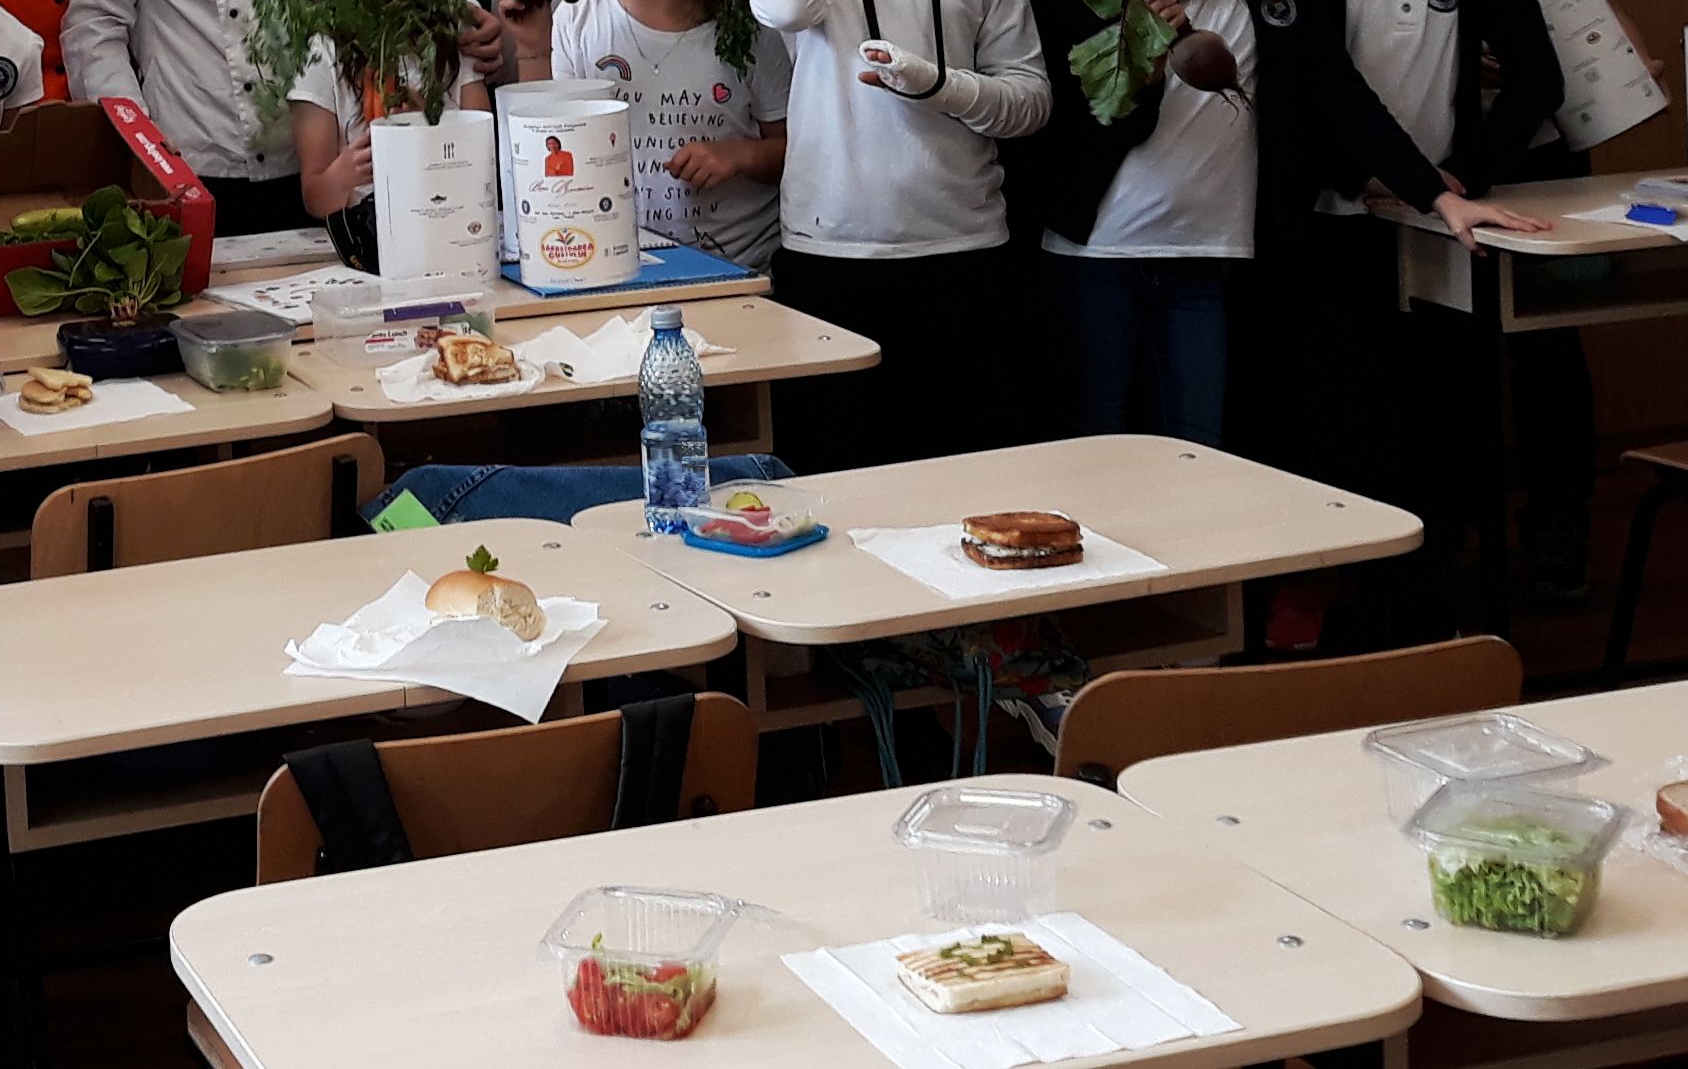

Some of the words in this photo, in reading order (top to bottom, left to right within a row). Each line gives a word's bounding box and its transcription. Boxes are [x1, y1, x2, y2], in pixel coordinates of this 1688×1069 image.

[660, 89, 702, 107] MAY
[648, 112, 725, 127] BELIEVING
[633, 135, 717, 150] UNICO
